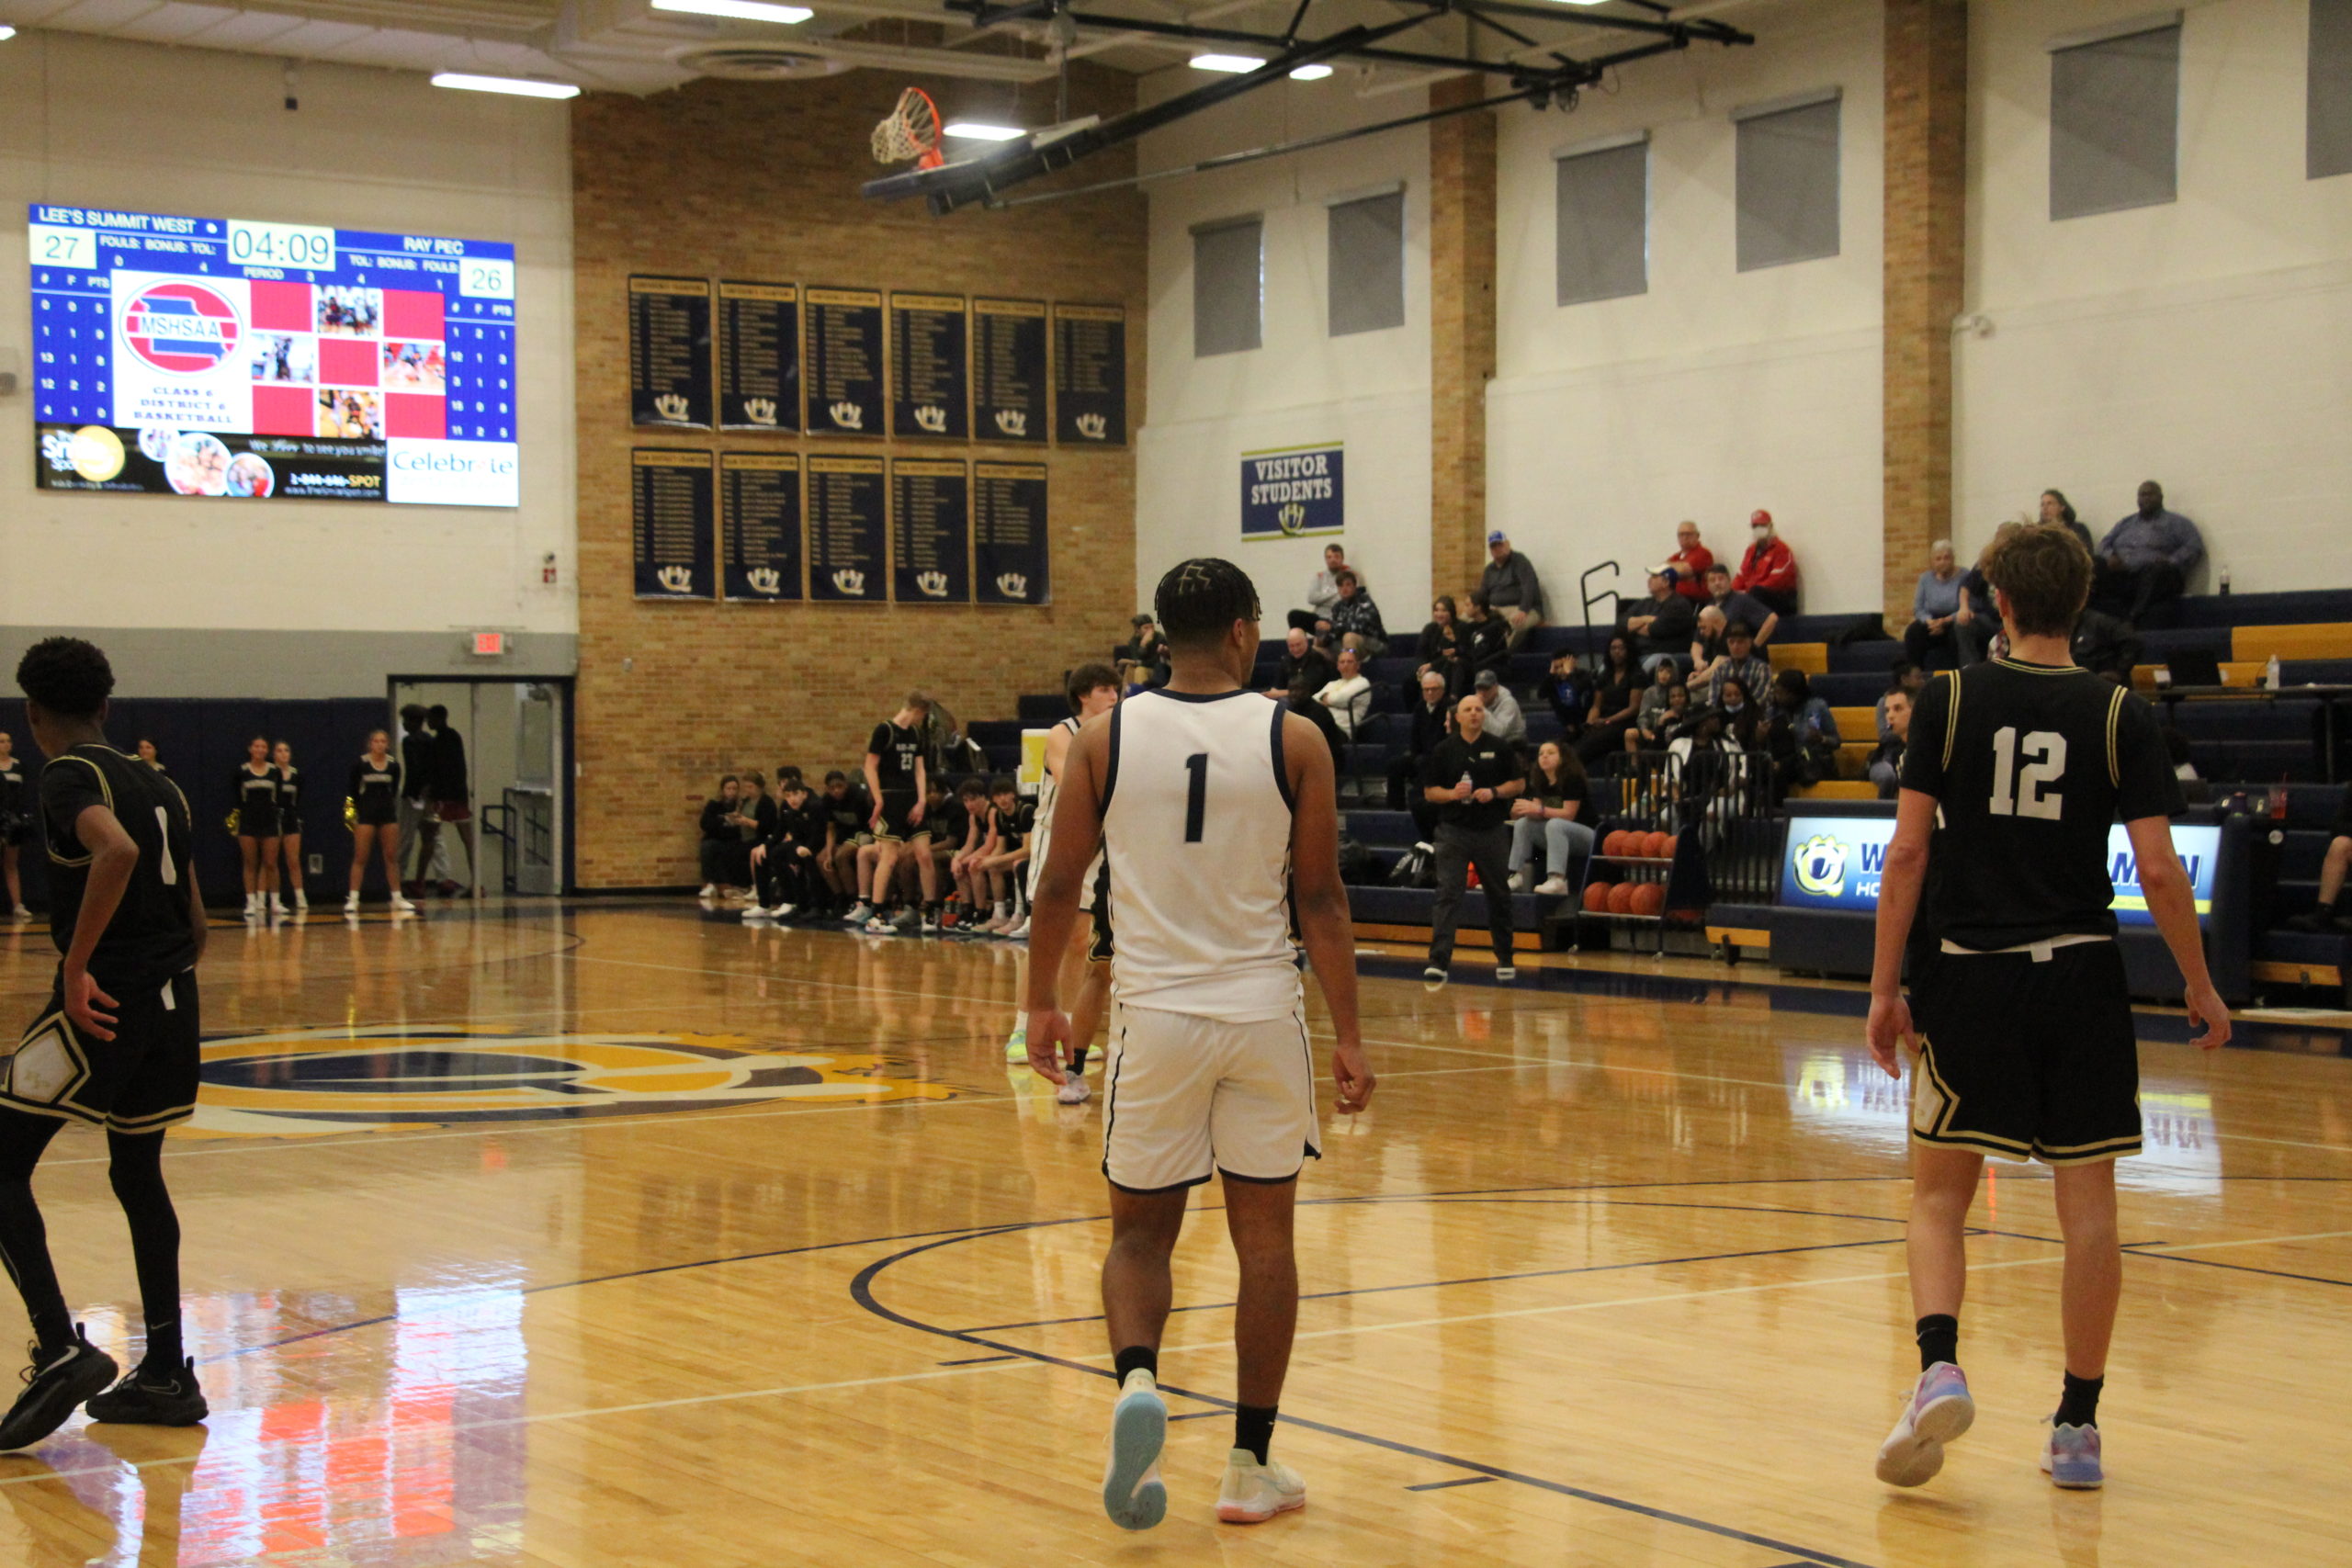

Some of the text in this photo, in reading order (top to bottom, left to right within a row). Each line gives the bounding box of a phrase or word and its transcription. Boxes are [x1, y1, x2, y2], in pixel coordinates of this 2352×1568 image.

[39, 207, 197, 234] LEE'S SUMMIT WEST
[45, 235, 79, 260] 27
[99, 234, 217, 255] FOULS: BONUS: TOL:
[233, 229, 329, 265] 04:09
[403, 236, 464, 255] RAY PEC
[243, 265, 284, 280] PERIOD
[348, 254, 373, 267] TOL:
[377, 256, 418, 271] BONUS:
[87, 276, 110, 288] PTS
[471, 267, 502, 292] 26
[141, 316, 220, 339] MSHSAA
[153, 387, 199, 396] CLASS
[141, 399, 211, 410] DISTRICT
[134, 412, 232, 423] BASKETBALL
[1255, 455, 1329, 481] VISITOR
[1251, 478, 1332, 505] STUDENTS
[1988, 725, 2067, 821] 12
[1183, 752, 1208, 843] 1
[154, 806, 177, 885] 1
